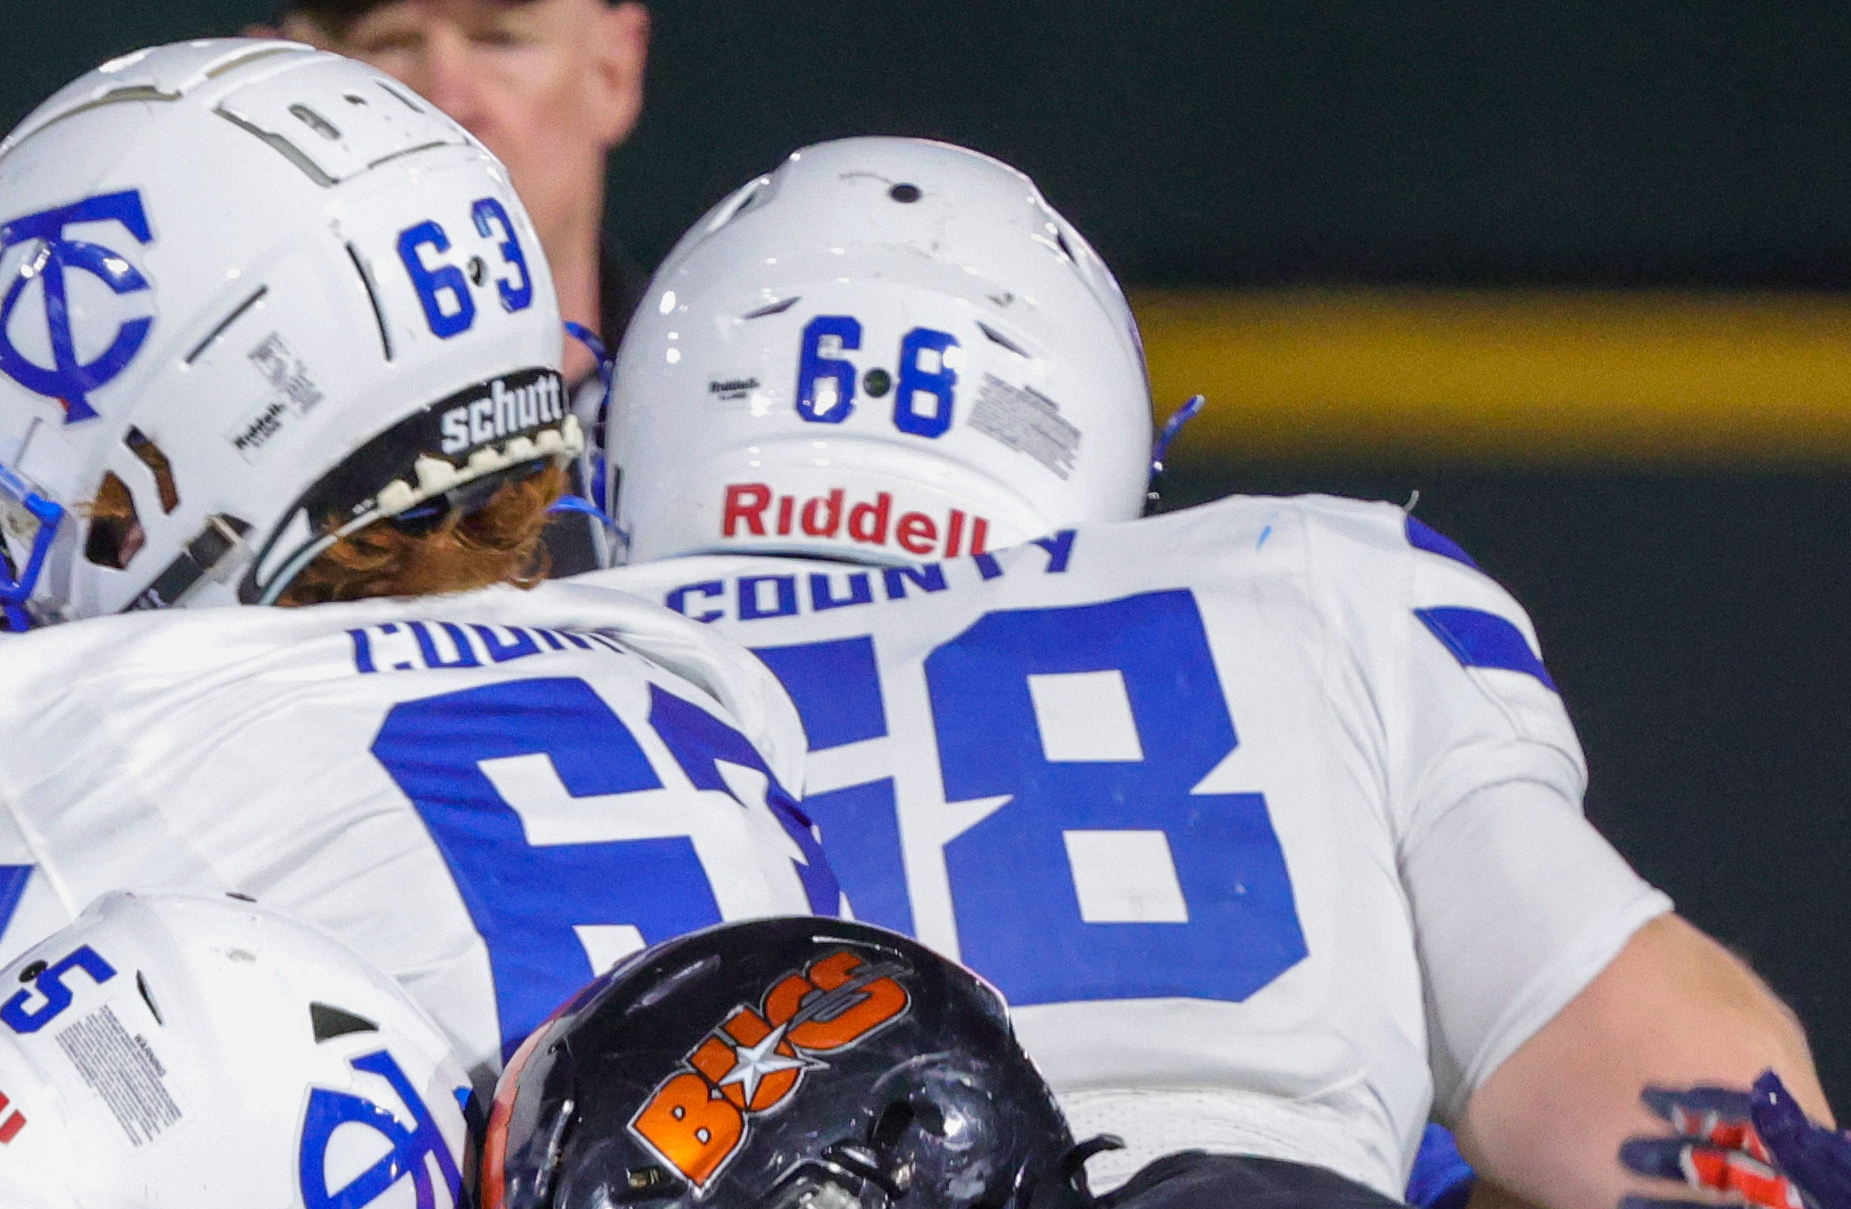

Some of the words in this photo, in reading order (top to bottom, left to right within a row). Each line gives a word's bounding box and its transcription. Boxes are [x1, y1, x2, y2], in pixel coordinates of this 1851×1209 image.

[396, 196, 533, 340] 63
[441, 373, 563, 455] schutt
[796, 315, 961, 439] 68
[723, 483, 990, 560] Riddell
